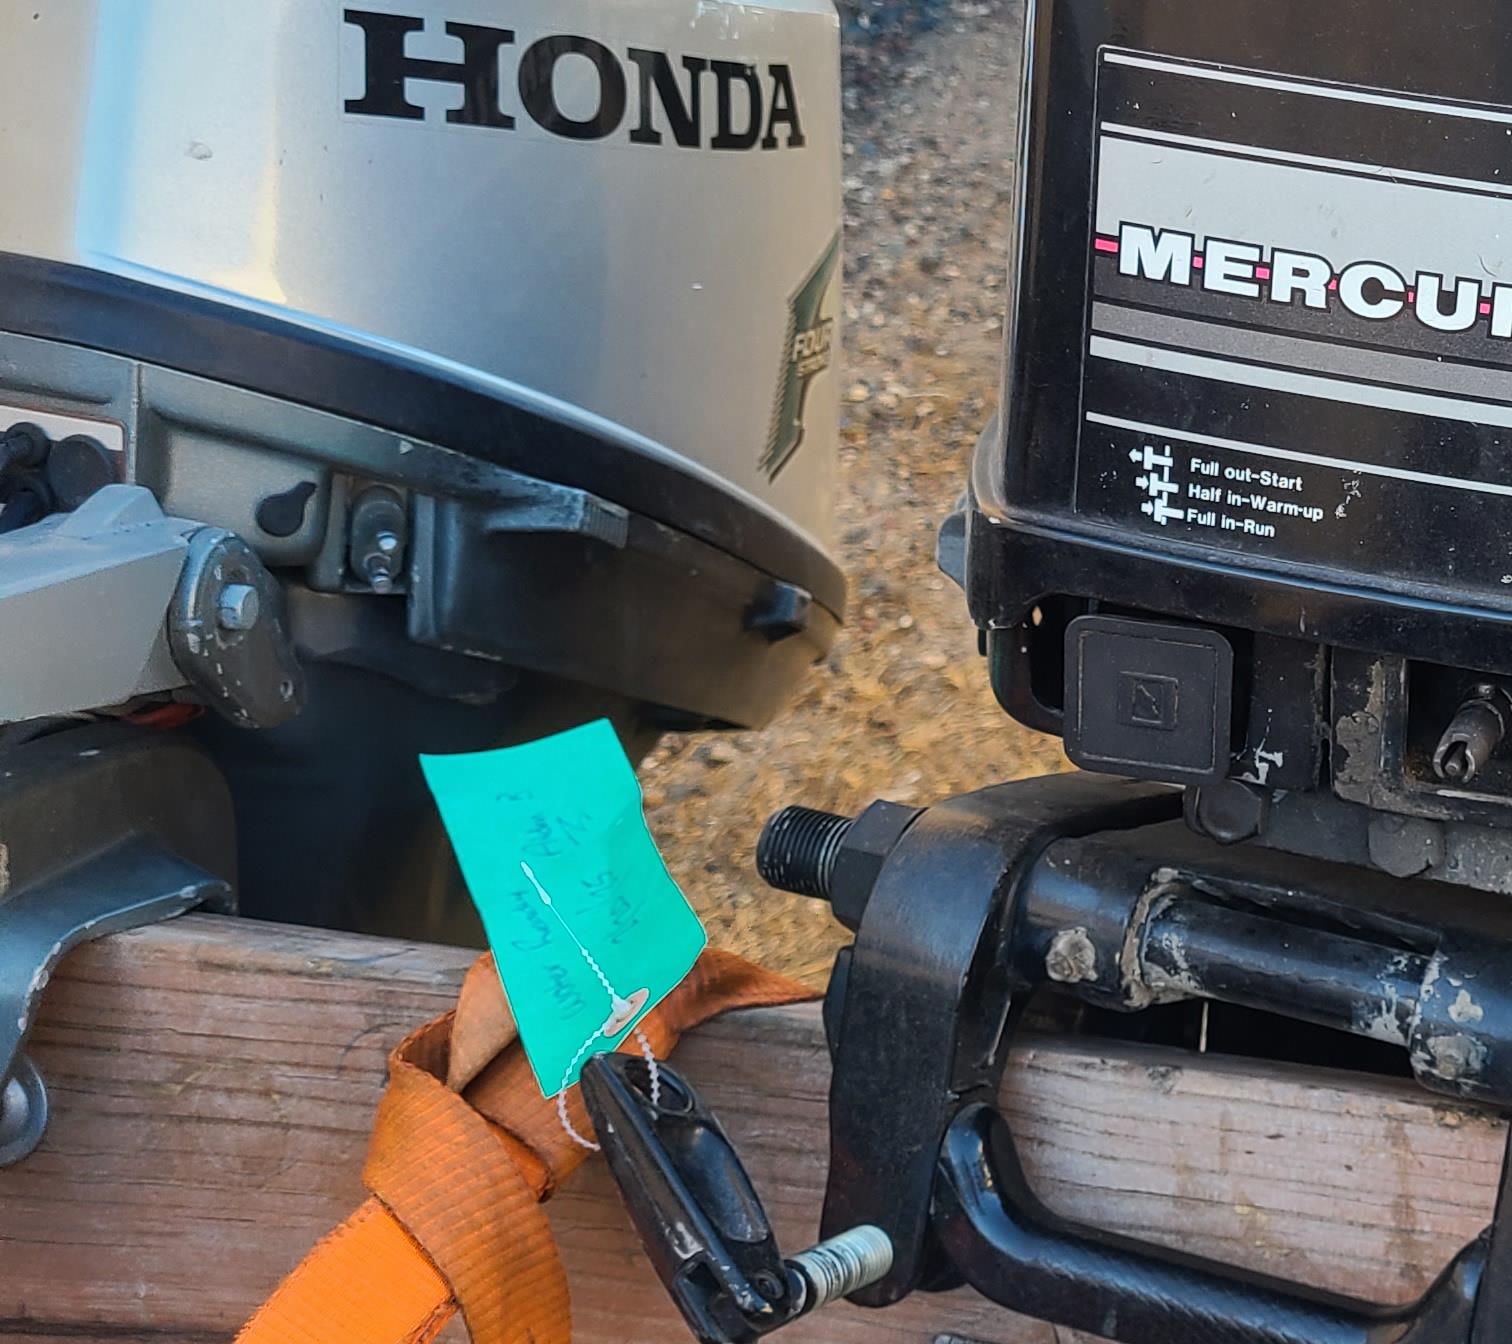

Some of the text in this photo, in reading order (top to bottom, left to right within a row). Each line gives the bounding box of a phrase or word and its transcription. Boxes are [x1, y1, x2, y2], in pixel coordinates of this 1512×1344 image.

[344, 8, 806, 152] HONDA
[1190, 457, 1303, 491] Full out-Start
[1188, 483, 1324, 522] Half in-Warm-up
[1186, 508, 1276, 537] Full in-Run
